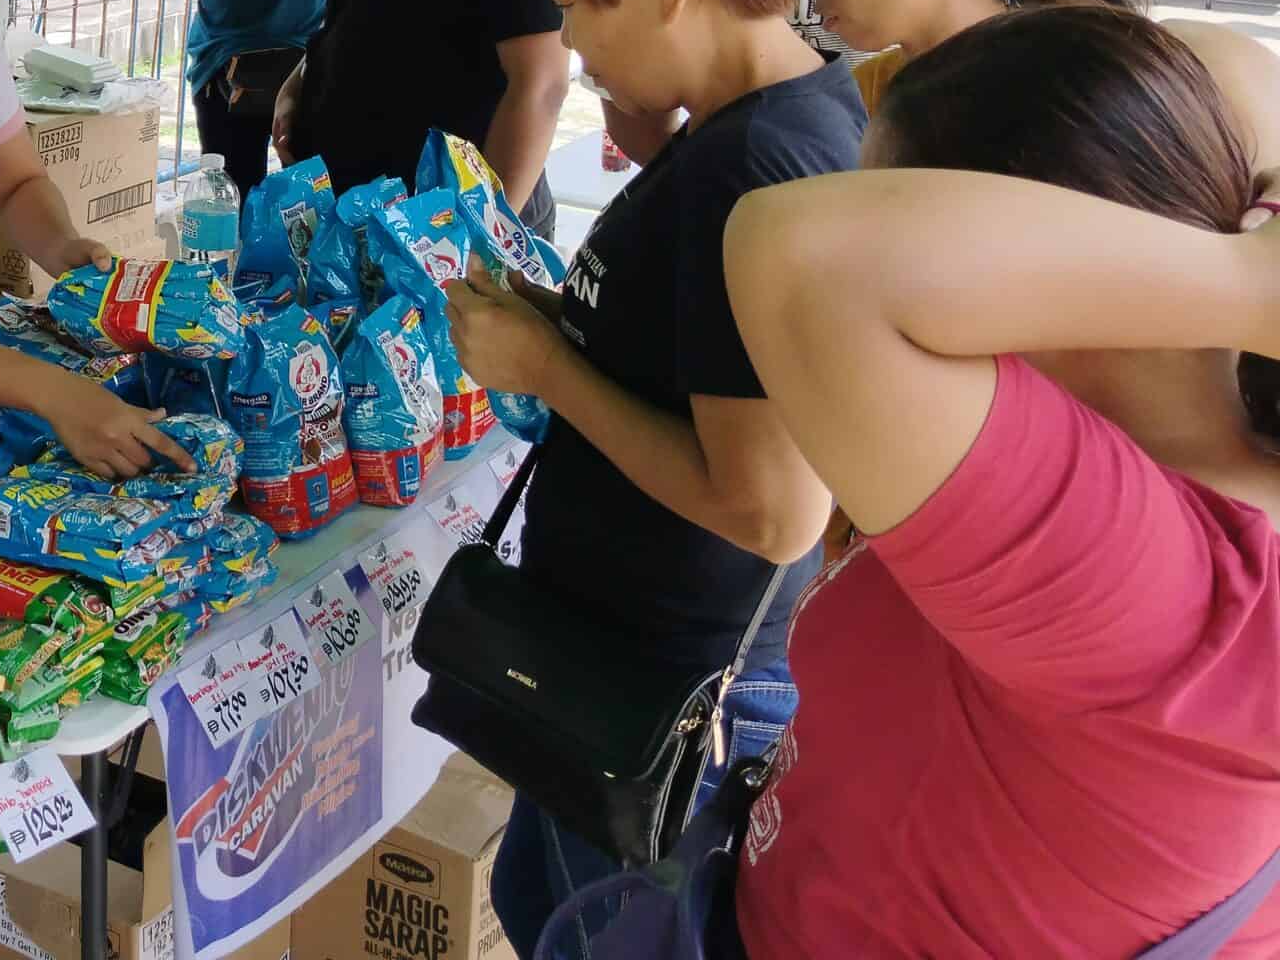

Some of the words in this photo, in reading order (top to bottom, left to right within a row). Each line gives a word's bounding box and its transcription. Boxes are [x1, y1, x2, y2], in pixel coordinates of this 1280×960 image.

[40, 126, 81, 150] 12528223
[59, 146, 80, 162] 300g
[228, 756, 305, 853] CARAVAN
[365, 878, 449, 936] MAGIC
[365, 908, 449, 960] SARAP
